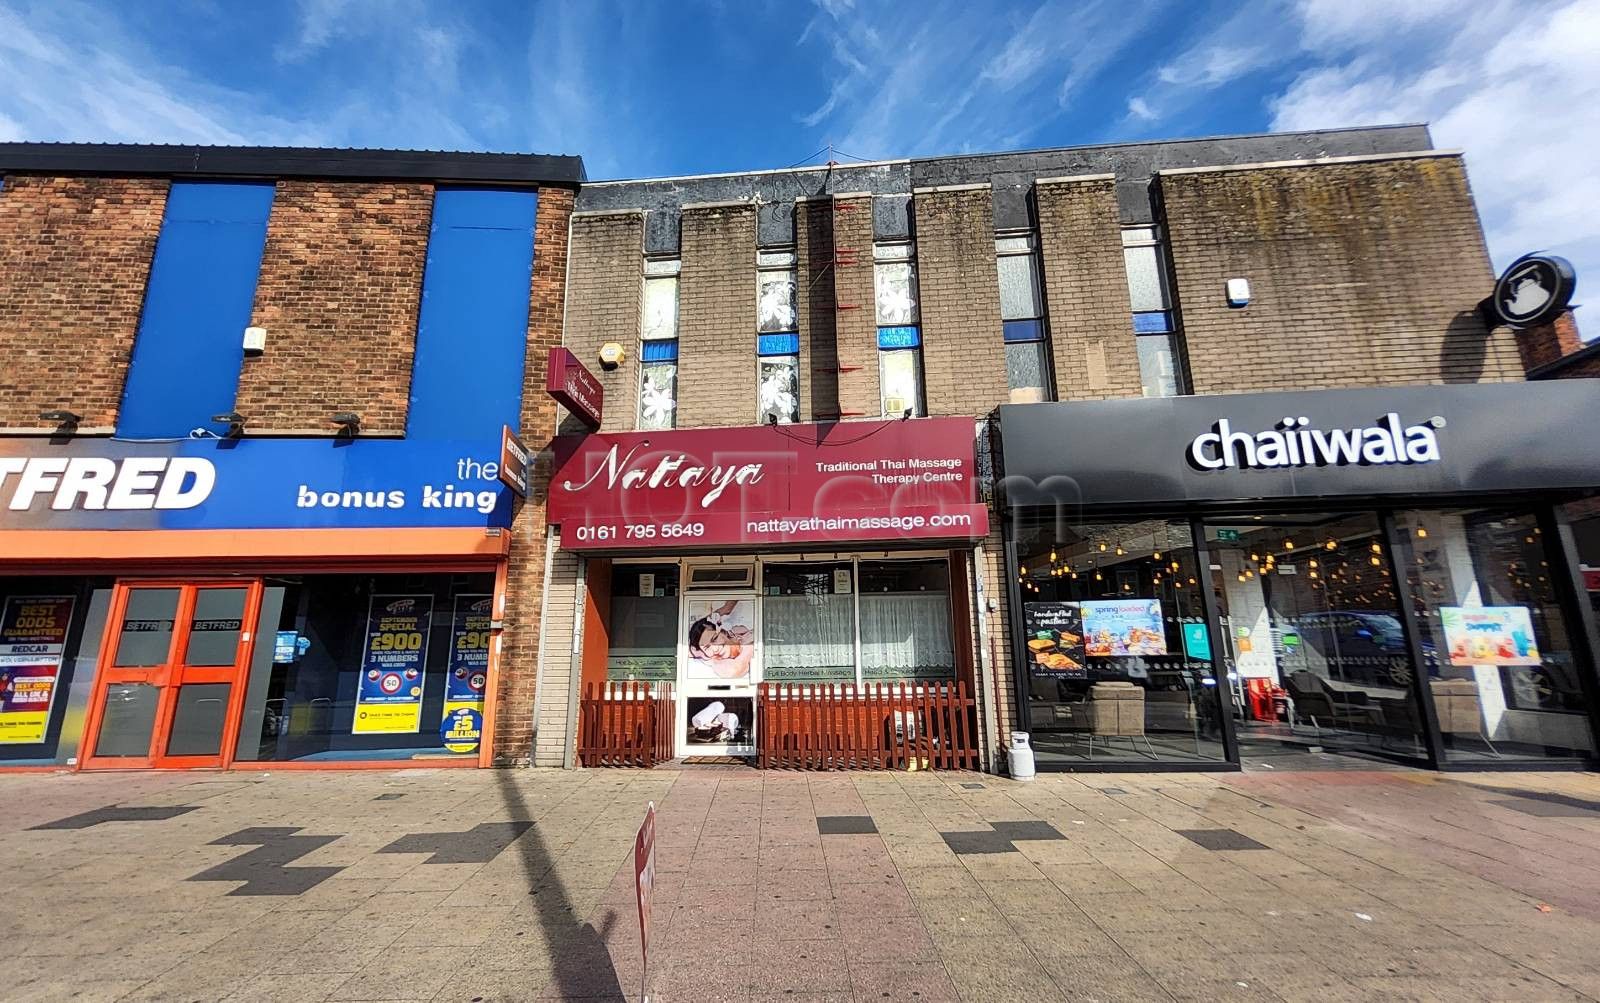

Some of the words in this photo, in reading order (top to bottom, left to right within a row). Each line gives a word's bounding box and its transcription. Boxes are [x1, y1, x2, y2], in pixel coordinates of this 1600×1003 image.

[457, 458, 499, 480] the
[816, 461, 877, 472] Traditional
[880, 460, 906, 470] Thai
[908, 458, 962, 469] Massage
[872, 474, 919, 484] Therapy
[922, 472, 963, 481] Centre
[297, 485, 405, 507] bonus
[422, 485, 497, 514] king
[747, 514, 971, 534] nattayathaimassage.com
[576, 525, 617, 540] 0161
[624, 524, 656, 539] 795
[660, 522, 705, 538] 5649
[20, 605, 57, 616] BEST
[16, 617, 57, 628] ODDS
[194, 621, 240, 630] BETFRED
[379, 623, 417, 631] SPECIAL
[4, 628, 64, 636] GUARANTEED
[370, 633, 422, 650] £900
[11, 645, 48, 653] REDCAR
[378, 654, 418, 662] NUMBERS
[454, 715, 474, 731] £5
[445, 730, 480, 738] MILLION
